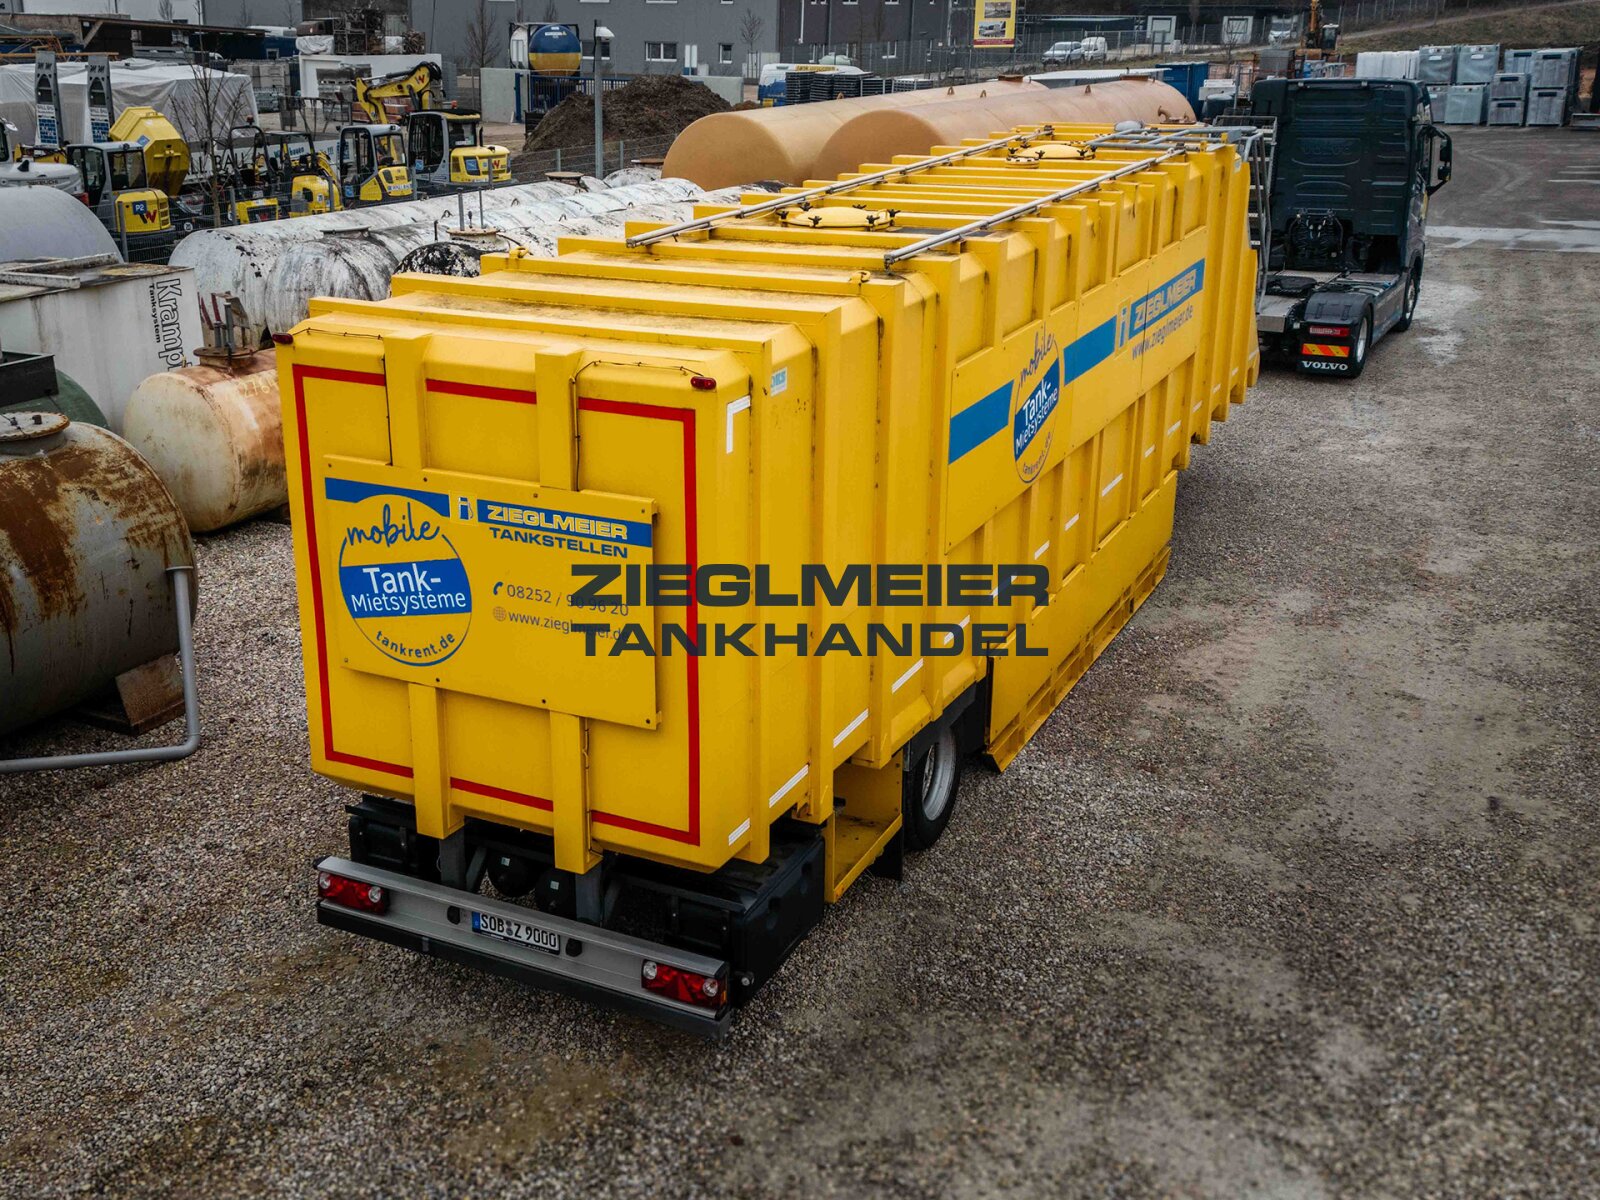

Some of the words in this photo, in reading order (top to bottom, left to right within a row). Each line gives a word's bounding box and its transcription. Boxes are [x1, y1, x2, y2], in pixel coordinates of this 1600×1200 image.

[149, 283, 161, 343] Tanksystem
[1133, 268, 1197, 331] ZIEGLMEIER
[157, 278, 193, 371] Kramp
[1020, 321, 1055, 388] mobile
[1302, 361, 1348, 371] VOLVO
[1023, 379, 1052, 426] Tank-
[1015, 388, 1058, 454] Mietsysteme
[347, 501, 440, 548] mobile
[487, 504, 628, 540] ZIEGLMEIER
[489, 526, 628, 559] TANKSTELLEN
[362, 563, 442, 594] Tank-
[506, 584, 552, 604] 08252
[351, 592, 467, 615] Mietsysteme
[375, 630, 456, 658] tankrent.de
[481, 914, 505, 933] SOB
[514, 924, 522, 939] Z
[525, 926, 557, 948] 9000
